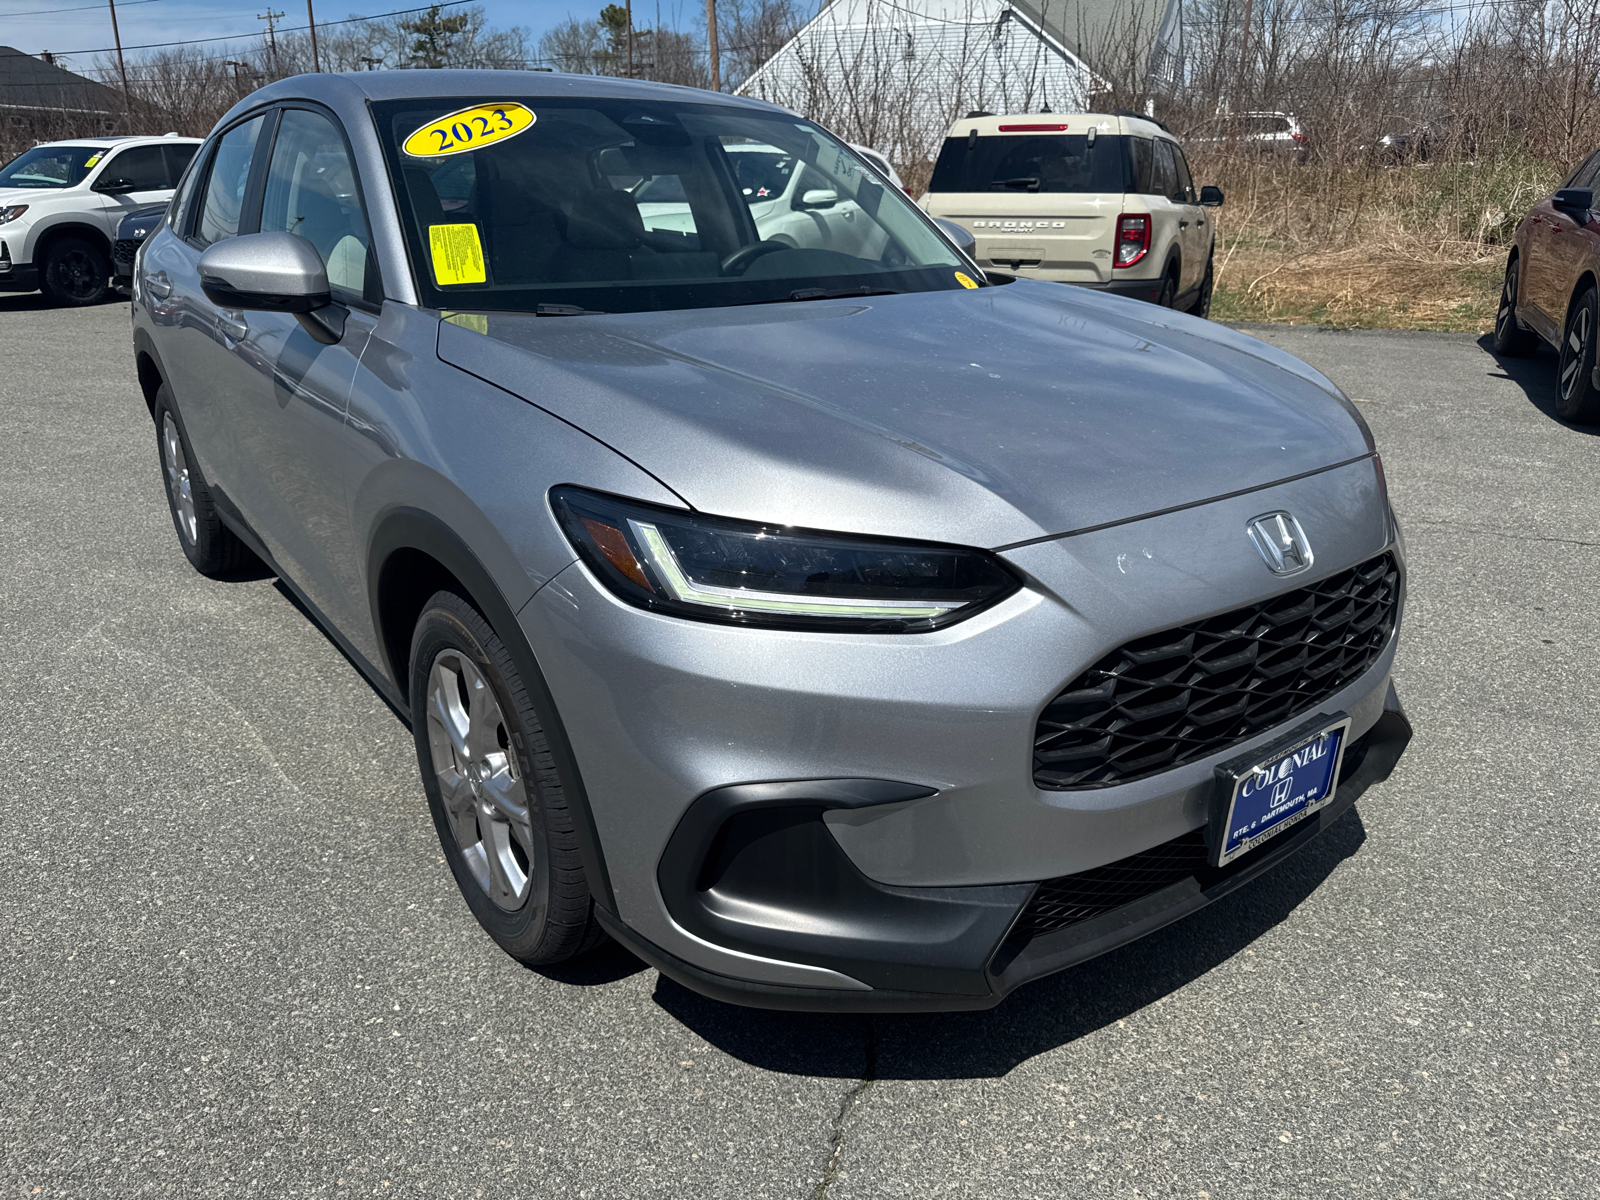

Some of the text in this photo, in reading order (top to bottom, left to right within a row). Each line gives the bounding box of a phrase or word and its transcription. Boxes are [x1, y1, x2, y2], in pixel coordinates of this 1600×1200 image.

[430, 109, 513, 151] 2023
[974, 221, 1066, 230] BRONCO
[1242, 740, 1327, 798] COLONIAL
[1233, 787, 1317, 839] RTE. 6 DARTMOUTH, MA
[1248, 810, 1307, 849] COLONIAL HONDA
